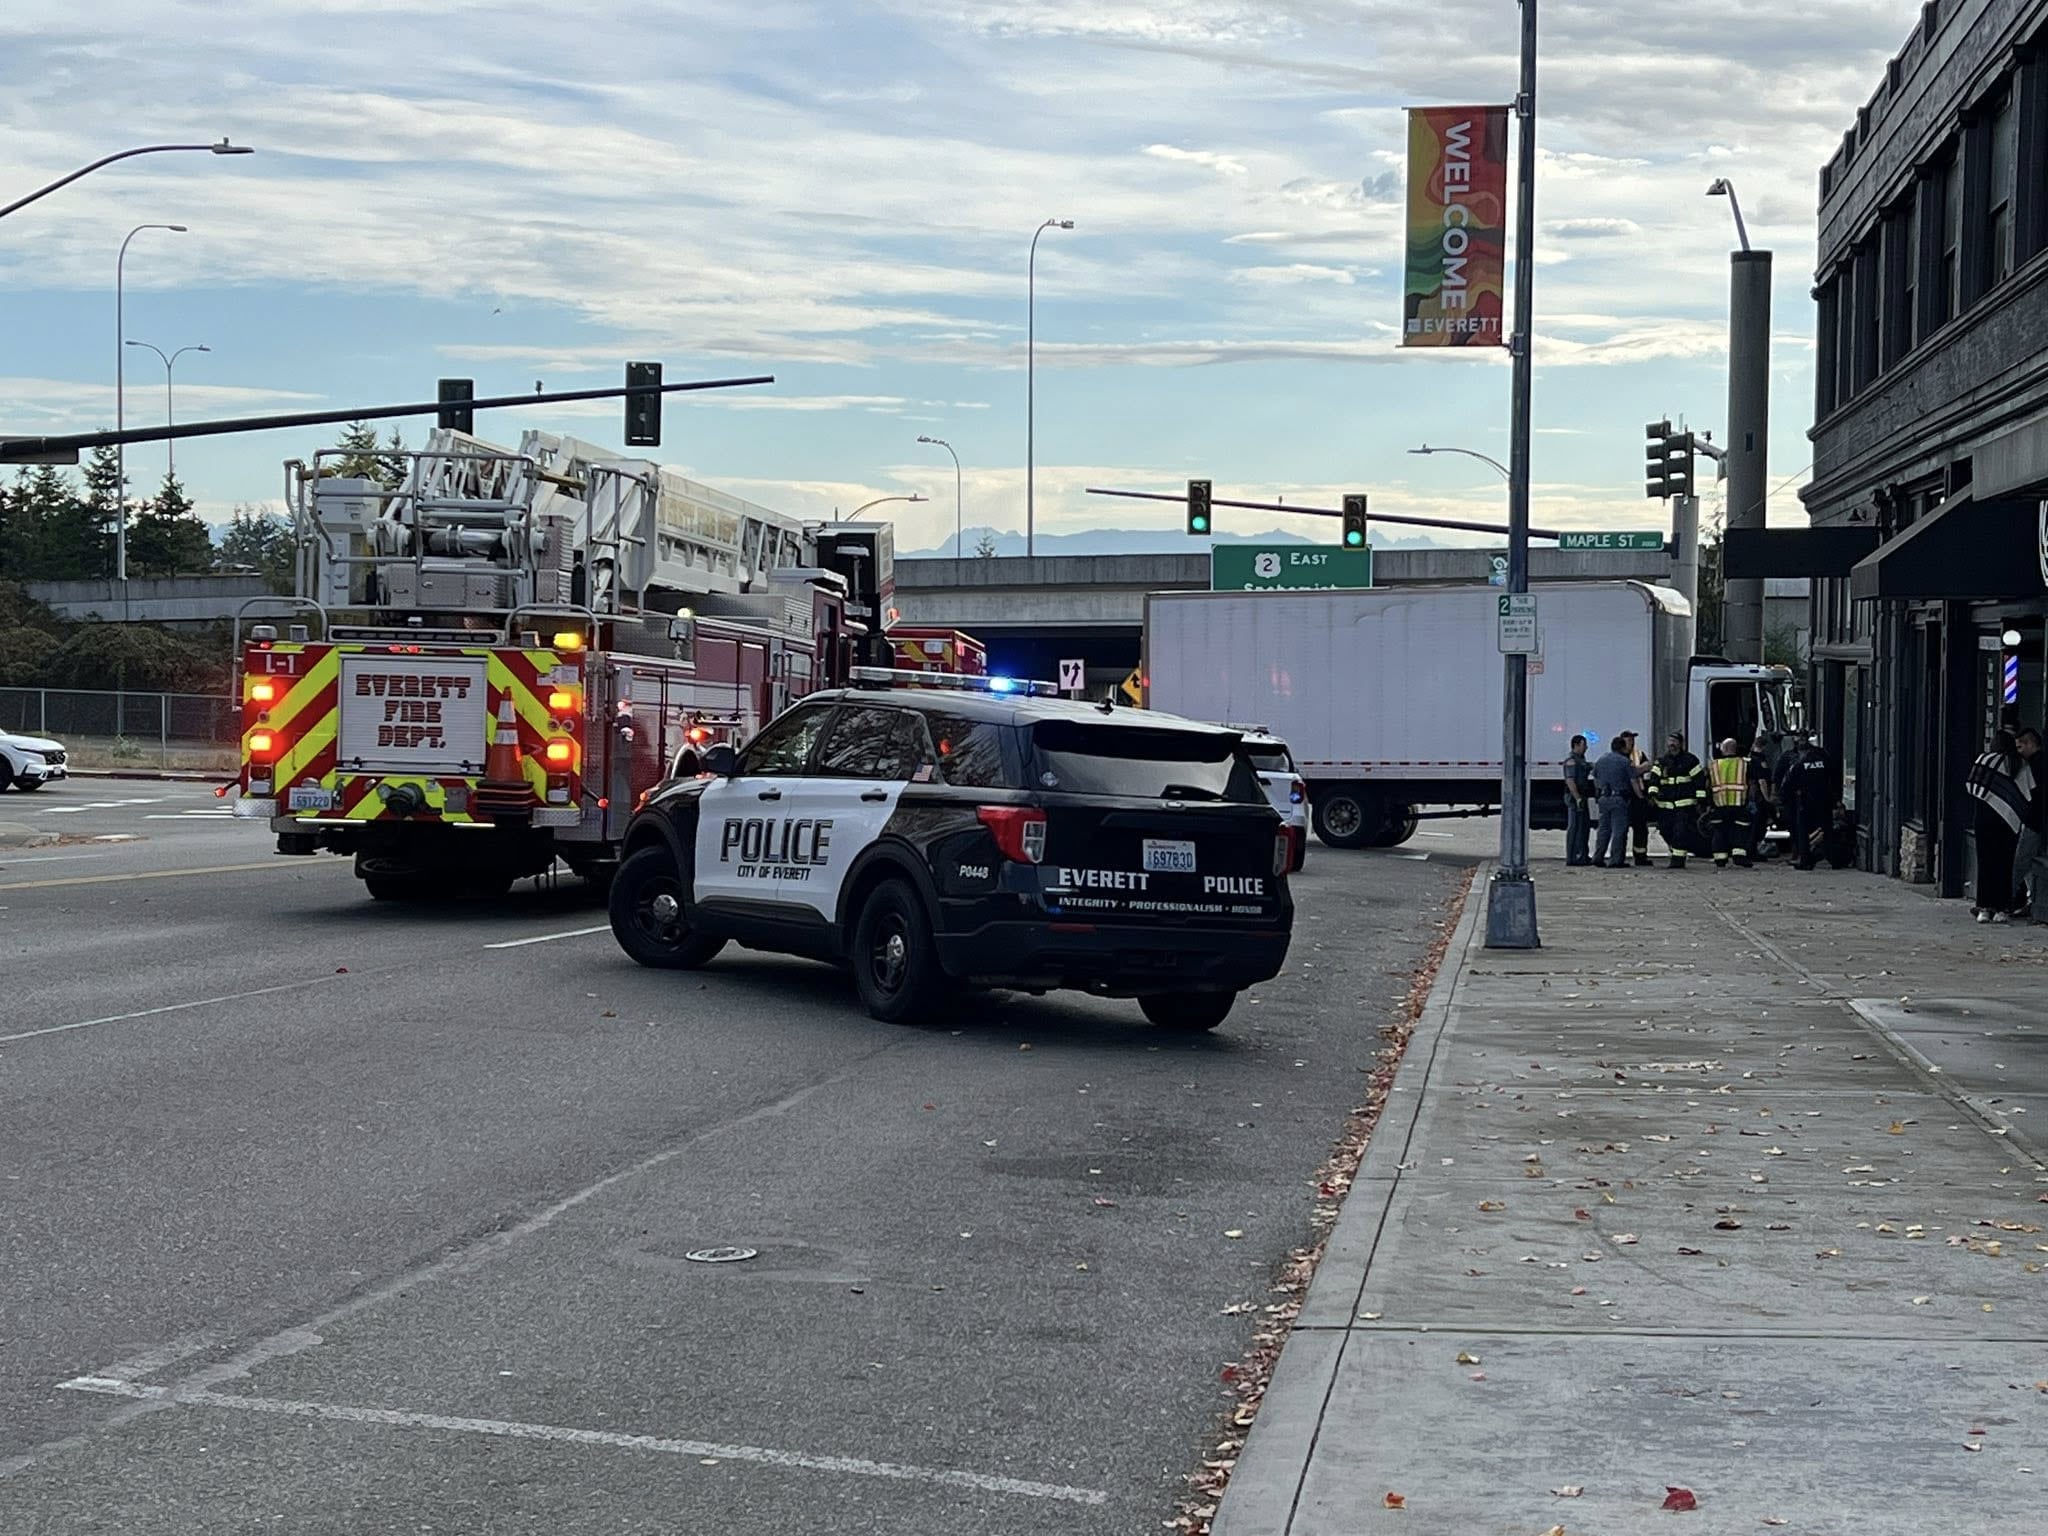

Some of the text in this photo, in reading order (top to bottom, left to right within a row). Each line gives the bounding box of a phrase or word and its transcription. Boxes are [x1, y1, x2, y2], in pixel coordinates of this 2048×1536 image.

[1440, 120, 1472, 310] WELCOME
[1423, 317, 1499, 334] EVERETT
[1566, 534, 1611, 547] MAPLE
[1618, 534, 1635, 547] ST
[1262, 552, 1328, 572] 2 EAST
[1500, 598, 1509, 614] 2
[265, 654, 296, 673] L-1
[355, 674, 472, 698] EVERETT
[384, 701, 442, 723] FIRE
[377, 725, 447, 748] DEPT.
[720, 818, 834, 865] POLICE
[737, 865, 812, 881] CITY OF EVERETT
[1059, 868, 1264, 895] EVERETT POLICE
[1058, 897, 1119, 908] INTEGRITY
[1129, 900, 1223, 913] PROFESSIONALISM
